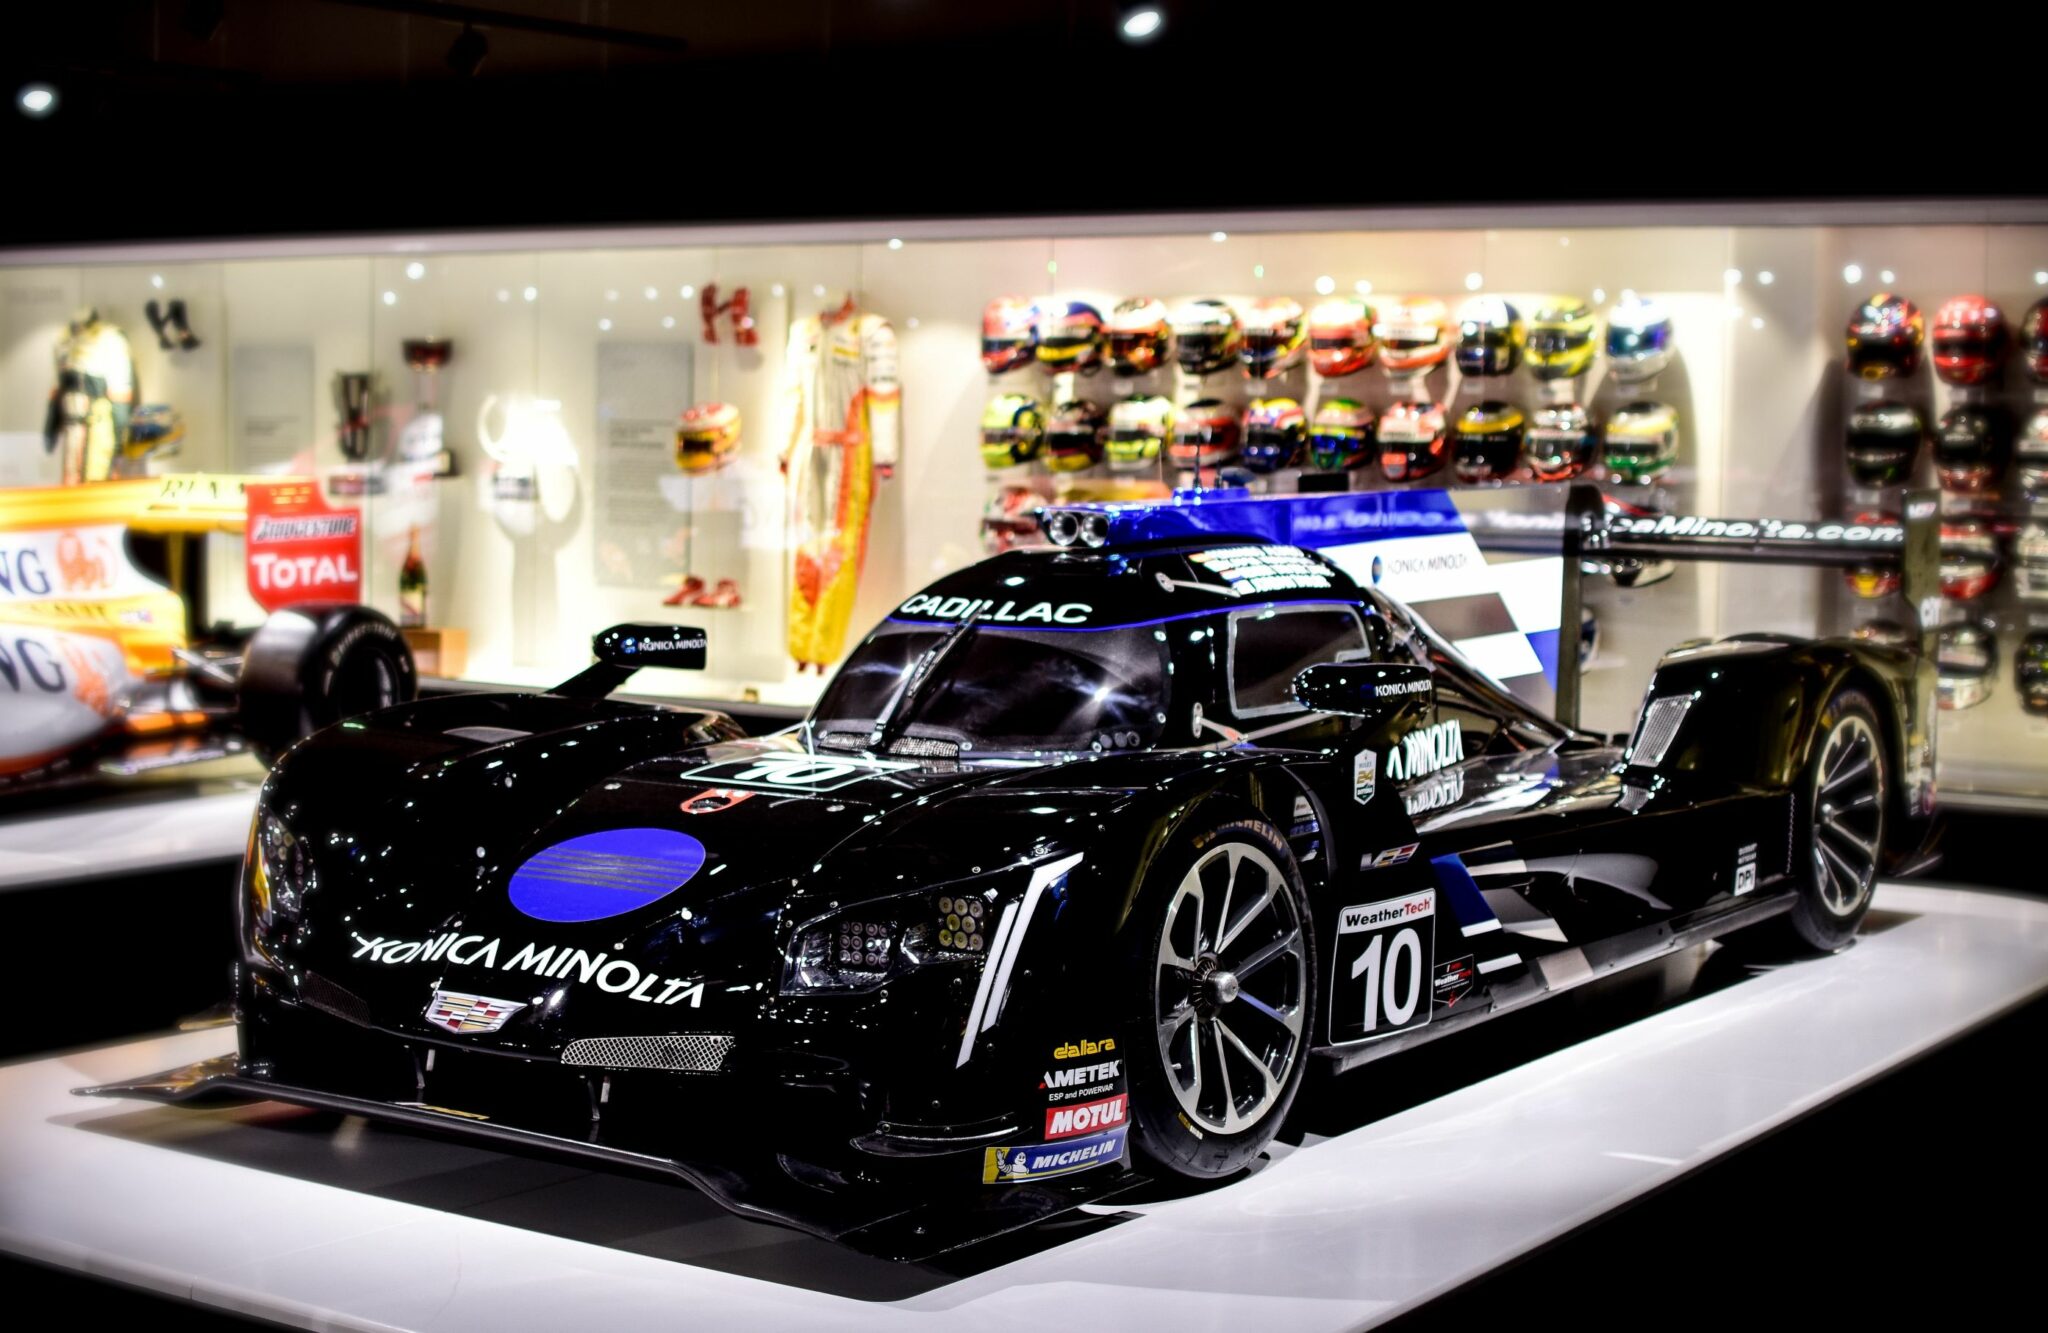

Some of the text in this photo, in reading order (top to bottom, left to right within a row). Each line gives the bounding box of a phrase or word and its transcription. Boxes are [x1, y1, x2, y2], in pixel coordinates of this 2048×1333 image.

[251, 553, 358, 589] TOTAL
[900, 594, 1093, 623] CADILLAC
[638, 638, 707, 652] KONICA MINOLTA
[1375, 679, 1432, 697] KONICA MINOLTA
[1402, 719, 1465, 780] MINOLTA
[733, 757, 856, 784] 10
[1346, 899, 1431, 927] WeatherTech
[352, 932, 705, 1008] KONICA MINOLTA
[1351, 927, 1422, 1032] 10
[1054, 1038, 1115, 1059] dallara
[1038, 1060, 1120, 1089] AMETEK
[1049, 1083, 1114, 1101] ESP and POWERVAR
[1050, 1100, 1124, 1134] MOTUL
[1032, 1139, 1116, 1169] MICHELIN
